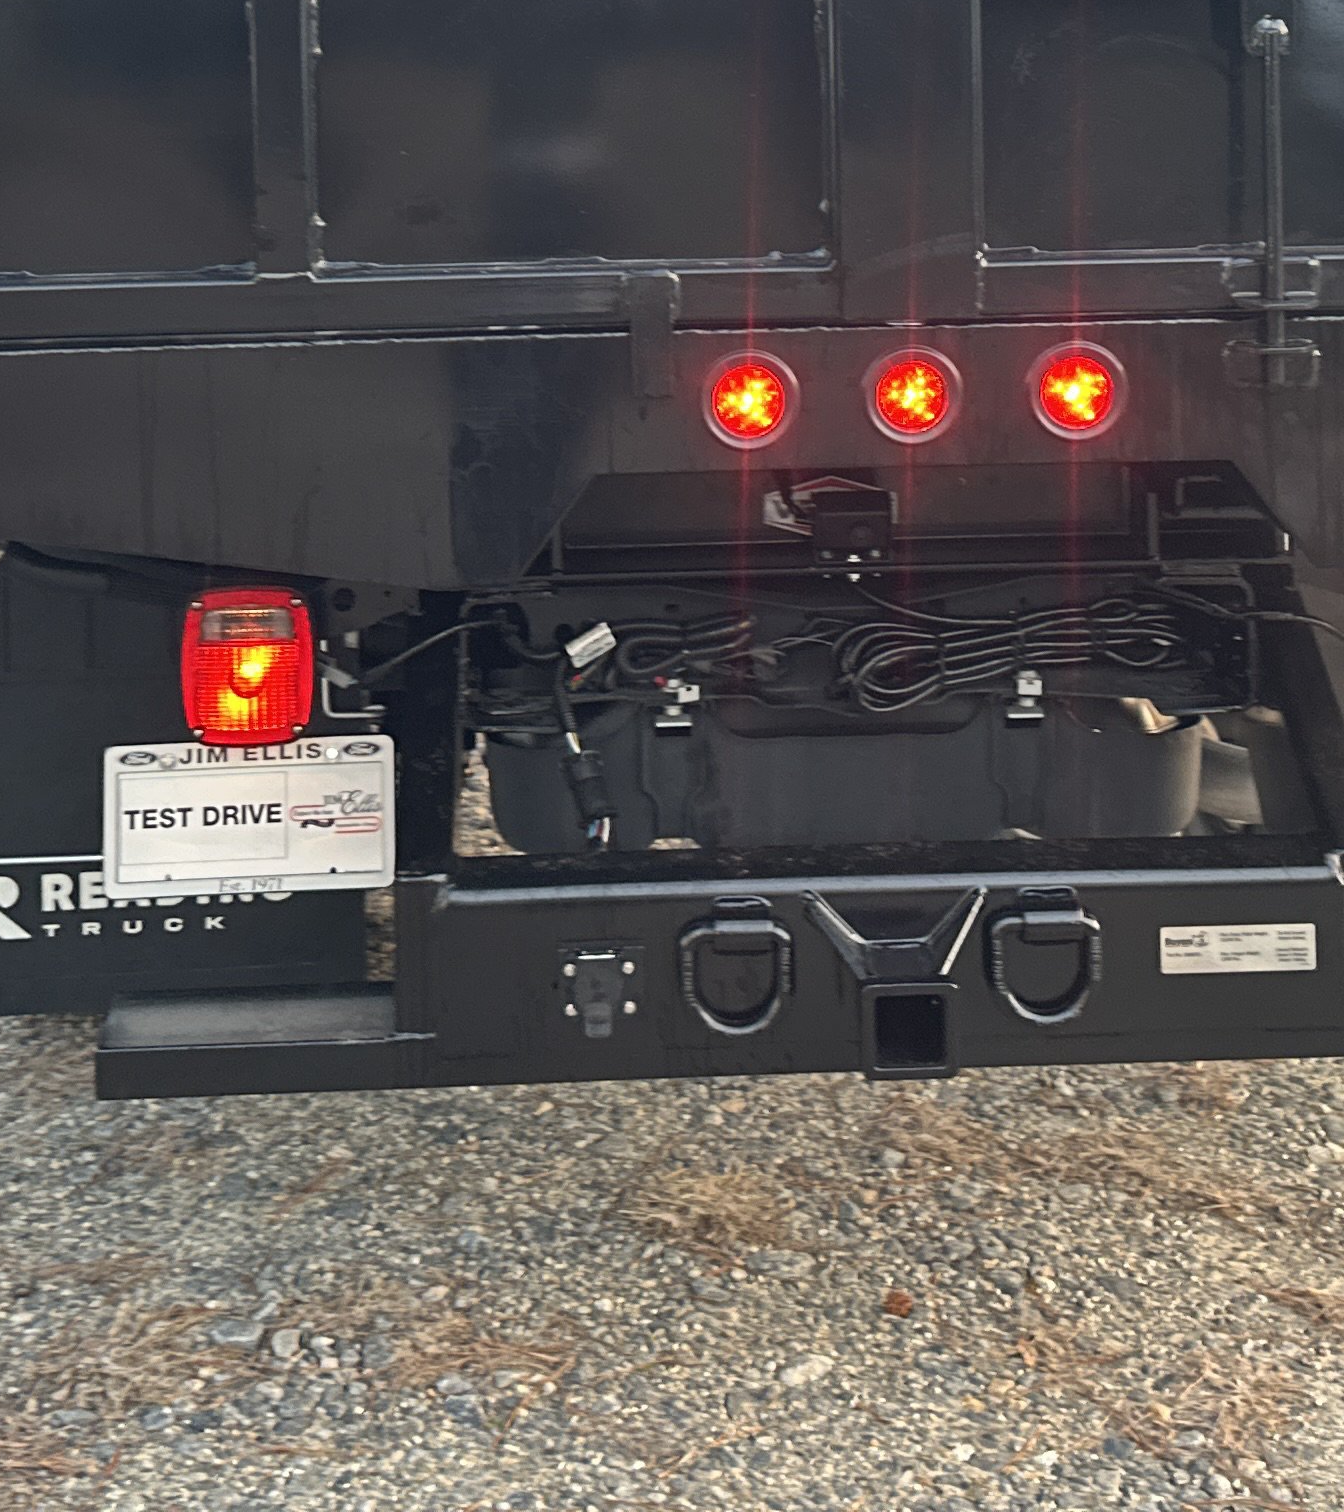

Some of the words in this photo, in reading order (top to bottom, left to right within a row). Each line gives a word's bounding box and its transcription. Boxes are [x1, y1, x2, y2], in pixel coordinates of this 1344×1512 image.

[179, 746, 229, 765] JIM
[243, 742, 322, 761] ELLIS
[124, 807, 193, 830] TEST
[203, 803, 283, 826] DRIVE
[41, 916, 226, 938] TRUCK
